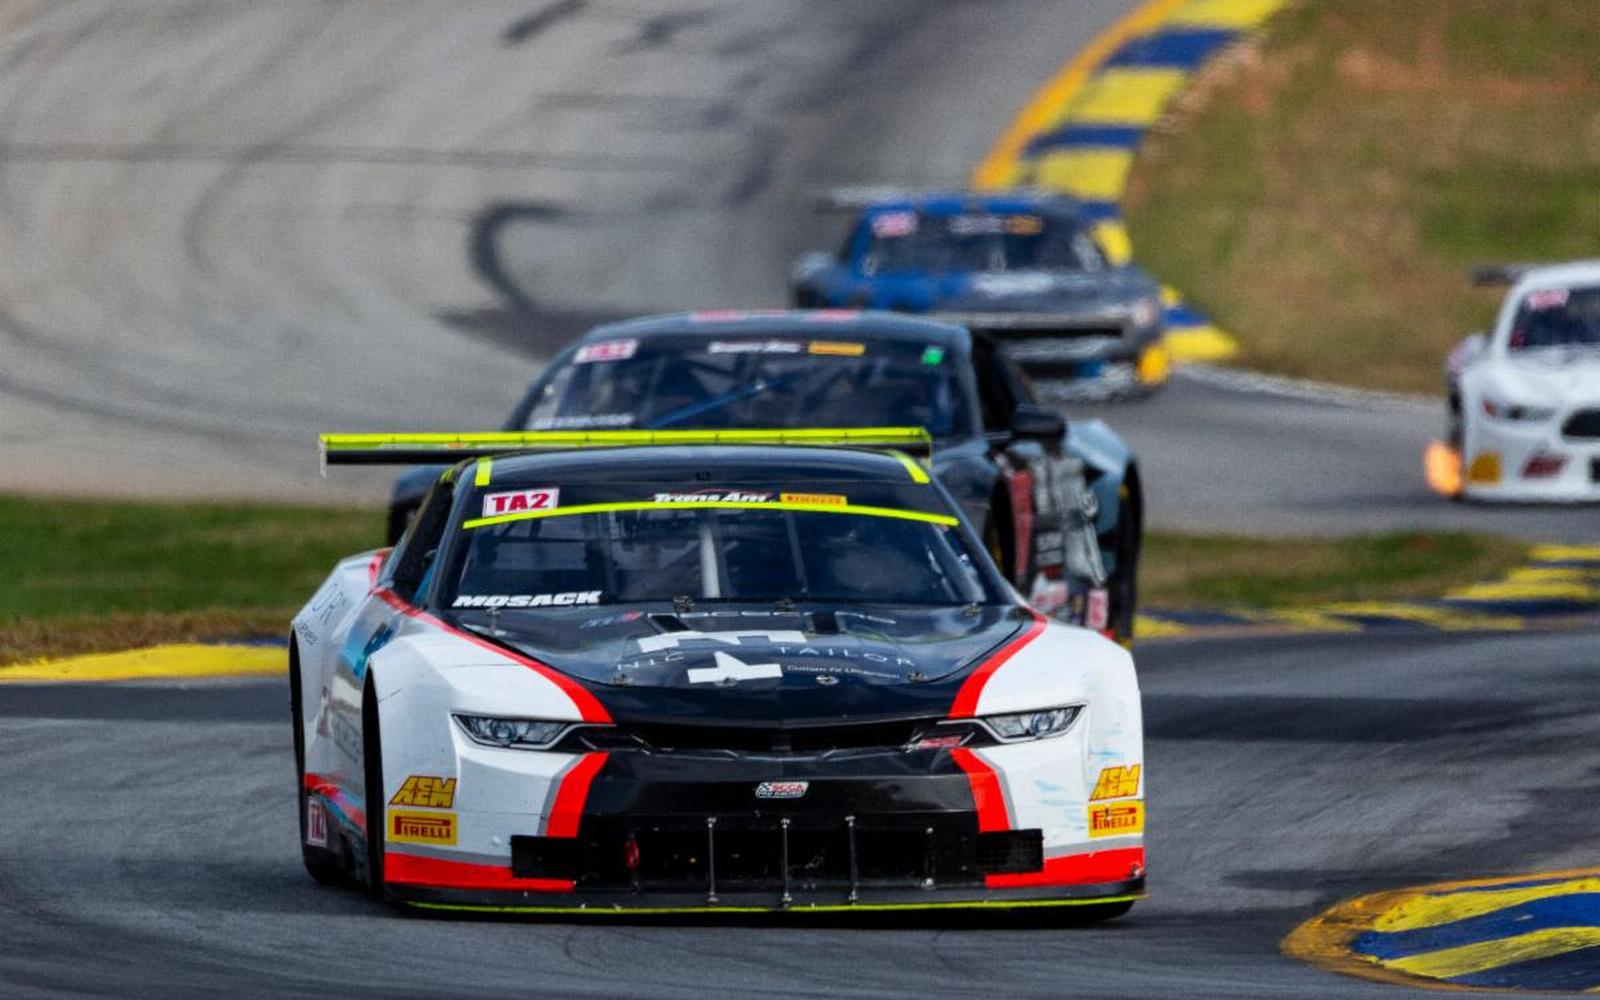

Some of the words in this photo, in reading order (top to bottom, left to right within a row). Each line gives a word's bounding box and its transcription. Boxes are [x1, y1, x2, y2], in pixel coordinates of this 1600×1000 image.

[491, 491, 550, 513] TA2
[451, 590, 602, 608] MOSACK
[775, 646, 916, 667] TAILOR
[387, 774, 458, 809] AEM
[1088, 763, 1142, 802] AEM
[393, 815, 451, 840] PIRELLI
[1092, 807, 1137, 830] PIRELLI
